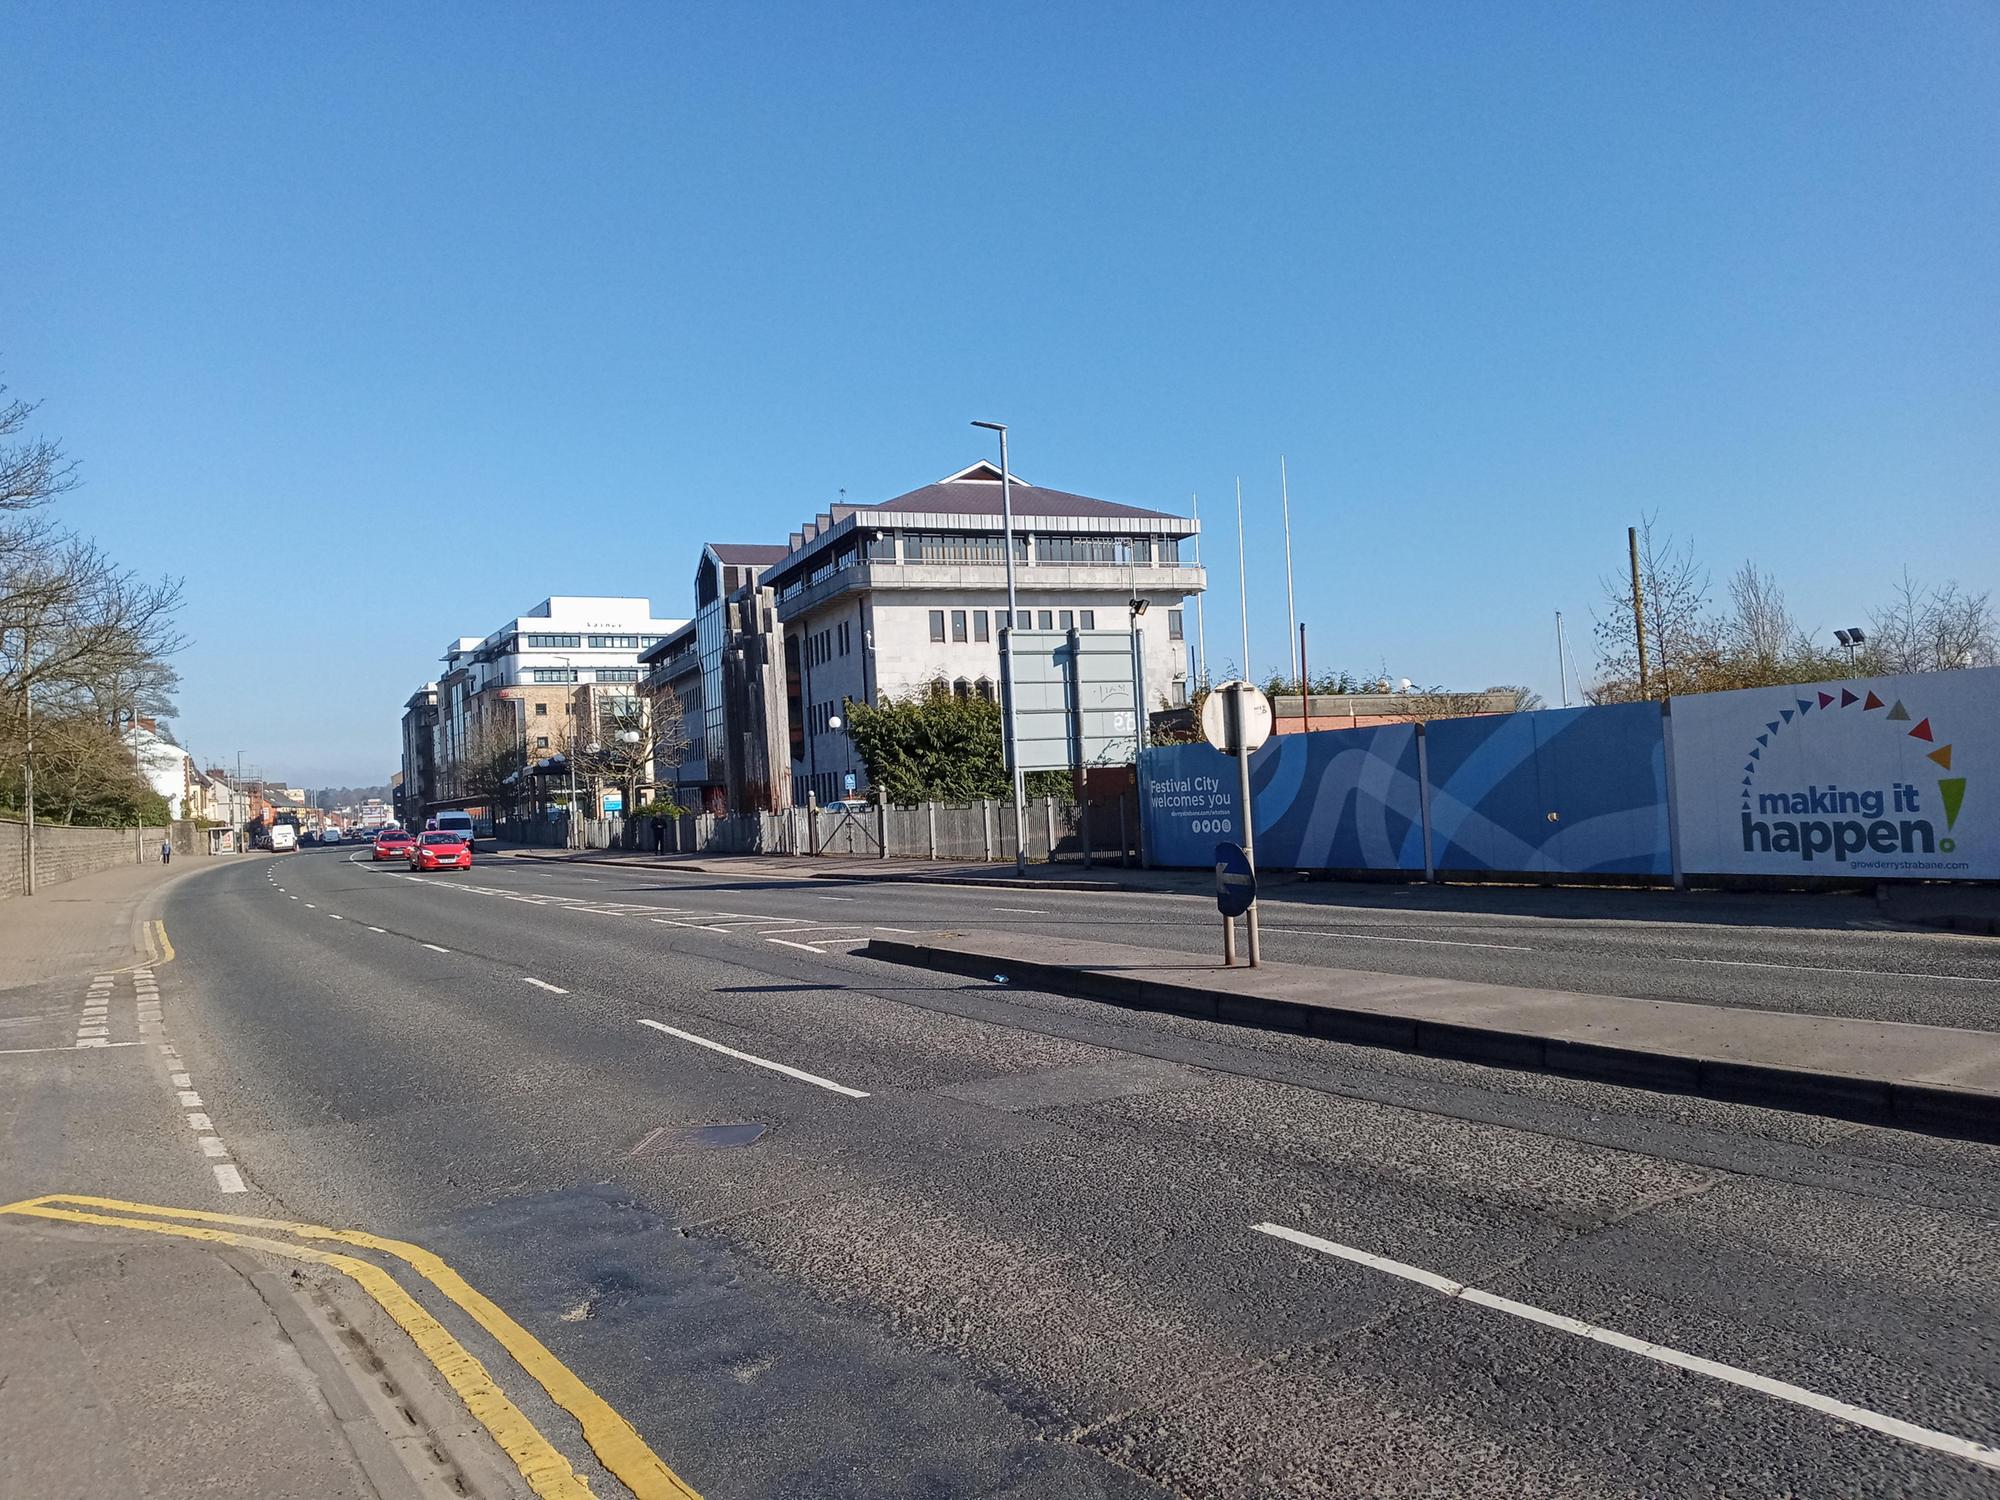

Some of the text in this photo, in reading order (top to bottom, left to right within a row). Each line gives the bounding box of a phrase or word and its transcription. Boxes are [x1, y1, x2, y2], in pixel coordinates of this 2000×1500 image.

[1151, 776, 1219, 793] Festival City
[1151, 793, 1231, 808] welcomes you
[1759, 782, 1920, 819] making it
[1850, 861, 1969, 870] growderrystrabane.com
